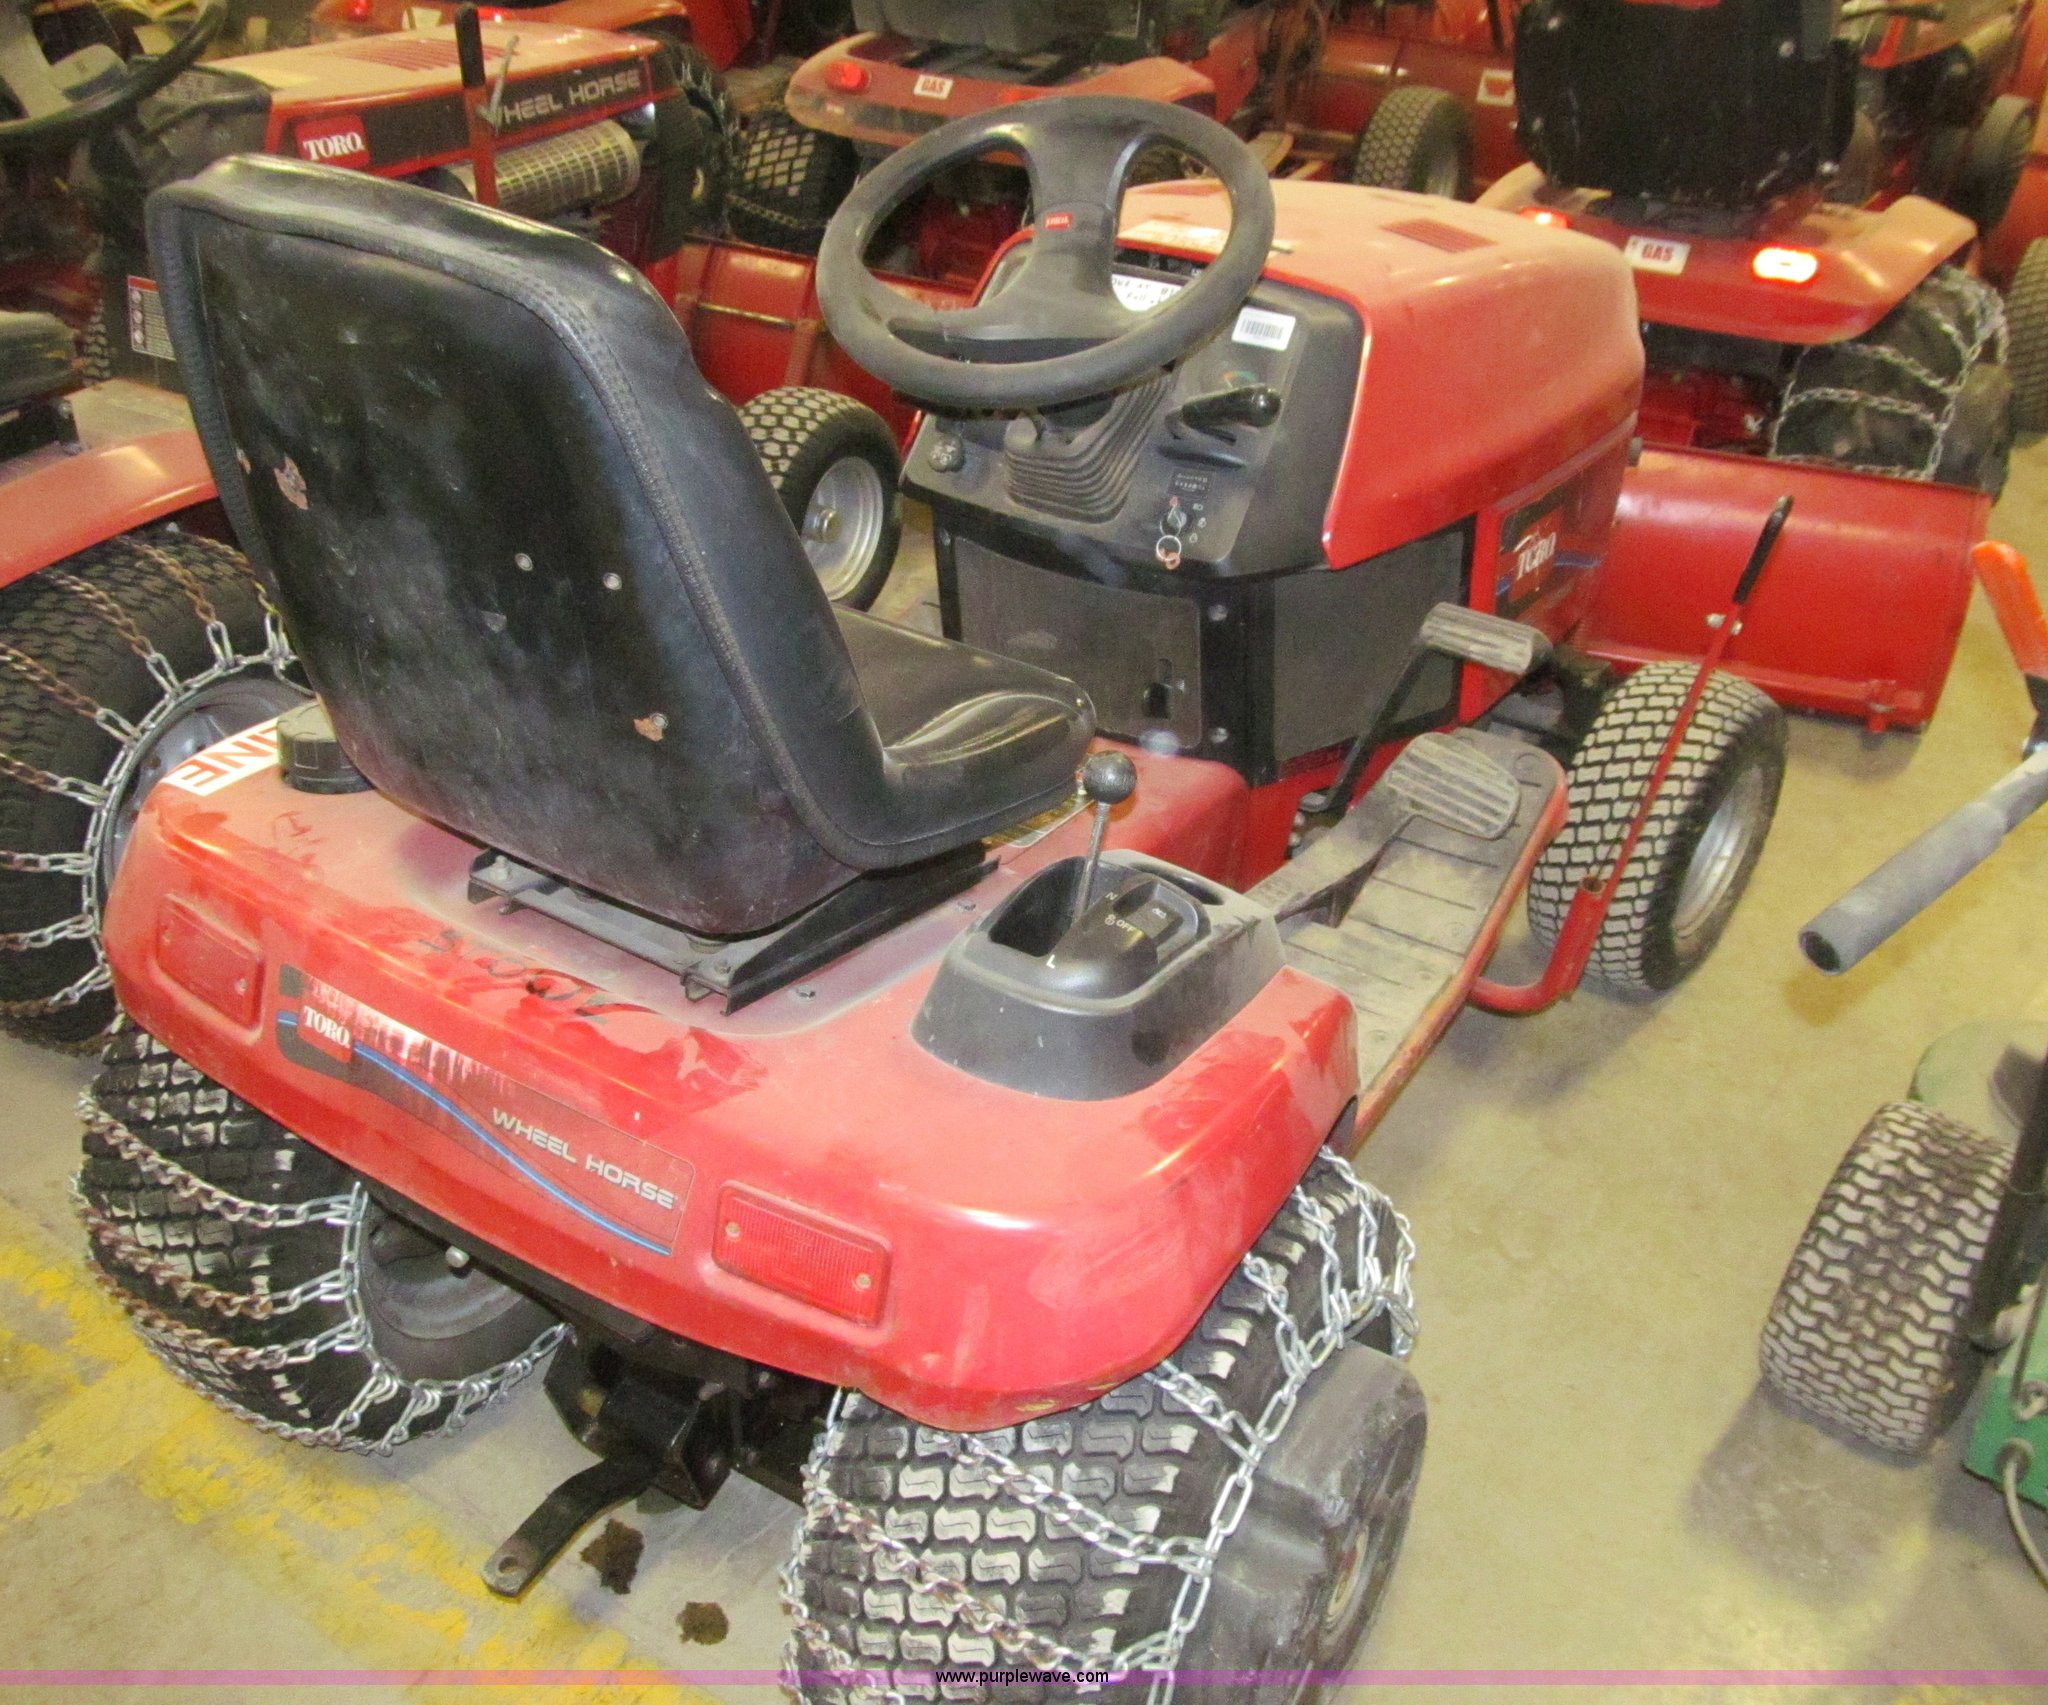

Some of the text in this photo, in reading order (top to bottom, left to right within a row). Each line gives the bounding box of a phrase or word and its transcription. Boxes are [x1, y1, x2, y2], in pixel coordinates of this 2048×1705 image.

[568, 69, 641, 105] HORSE
[302, 132, 362, 161] TORO
[1642, 243, 1674, 263] GAS
[1115, 919, 1135, 933] OFF
[1045, 954, 1056, 969] L
[303, 1004, 351, 1048] TORO
[492, 1106, 676, 1211] WHEEL HORSE
